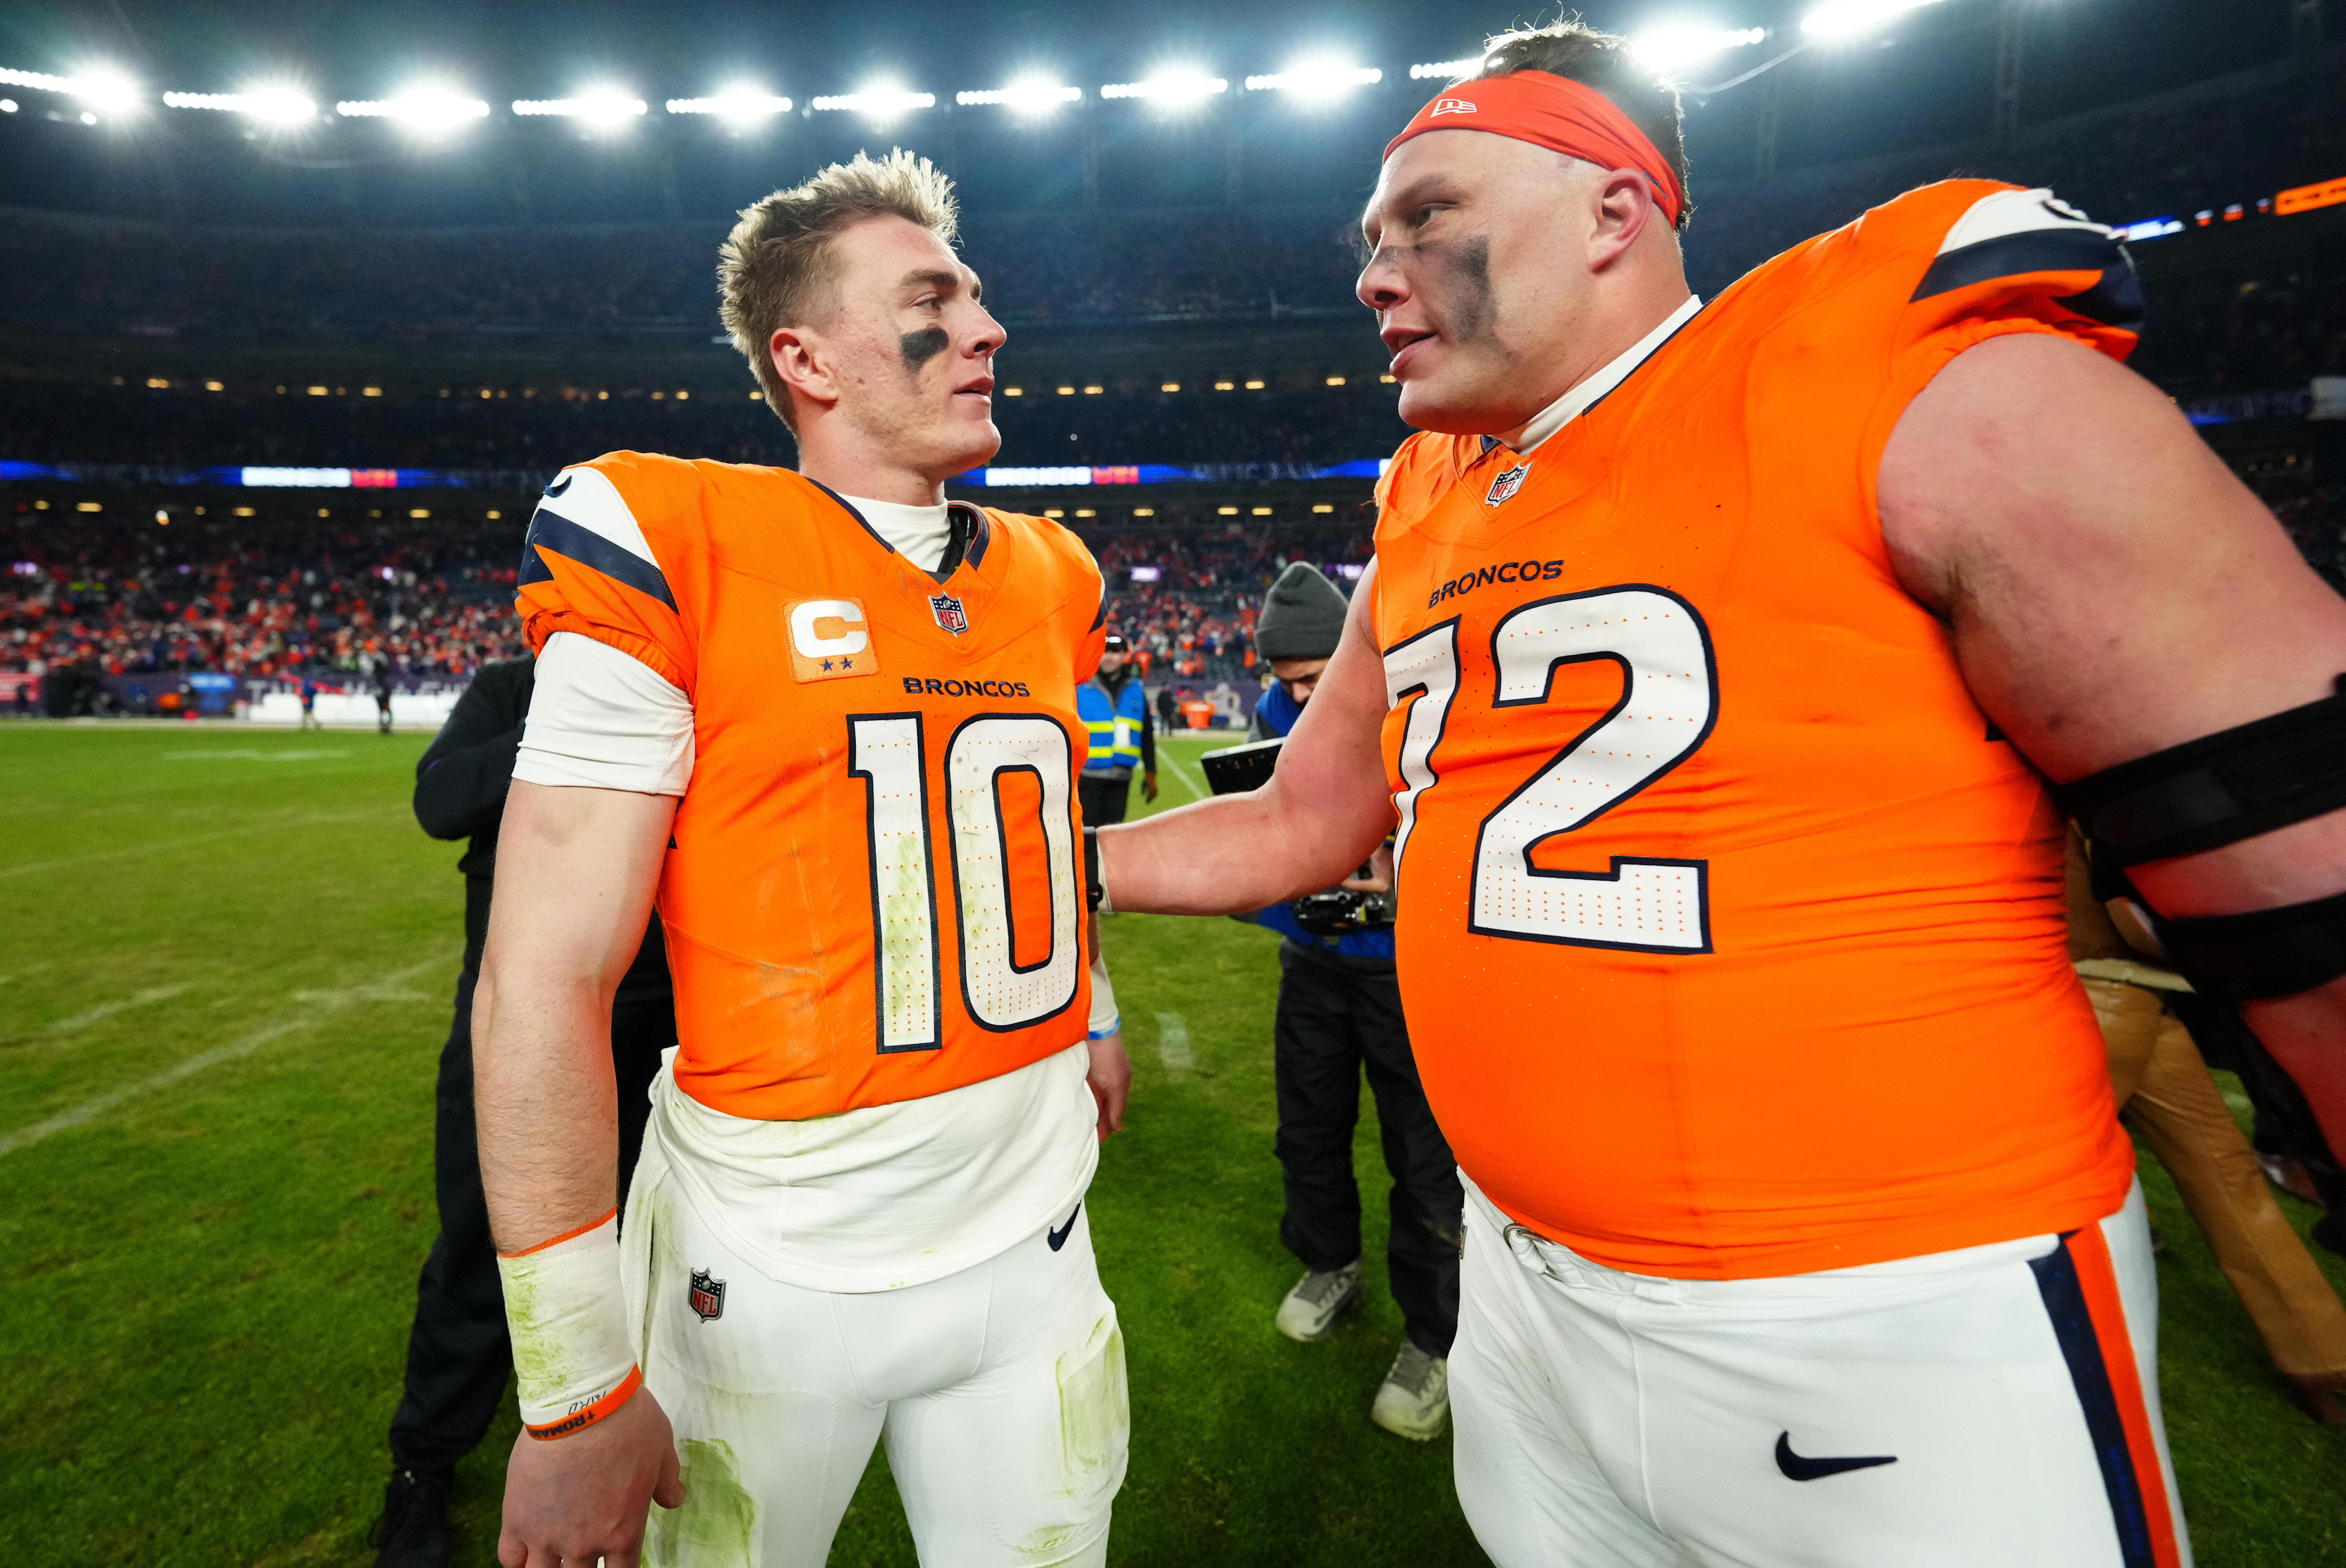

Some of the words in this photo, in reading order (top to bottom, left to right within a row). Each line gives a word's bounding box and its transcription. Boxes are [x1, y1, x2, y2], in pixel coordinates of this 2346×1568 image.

[1491, 480, 1516, 498] NFL
[1428, 559, 1563, 609] BRONCOS
[791, 600, 866, 658] C
[938, 610, 964, 628] NFL
[902, 676, 1031, 697] BRONCOS
[1382, 582, 1719, 953] 72
[848, 713, 1081, 1053] 10
[693, 1289, 717, 1314] NFL
